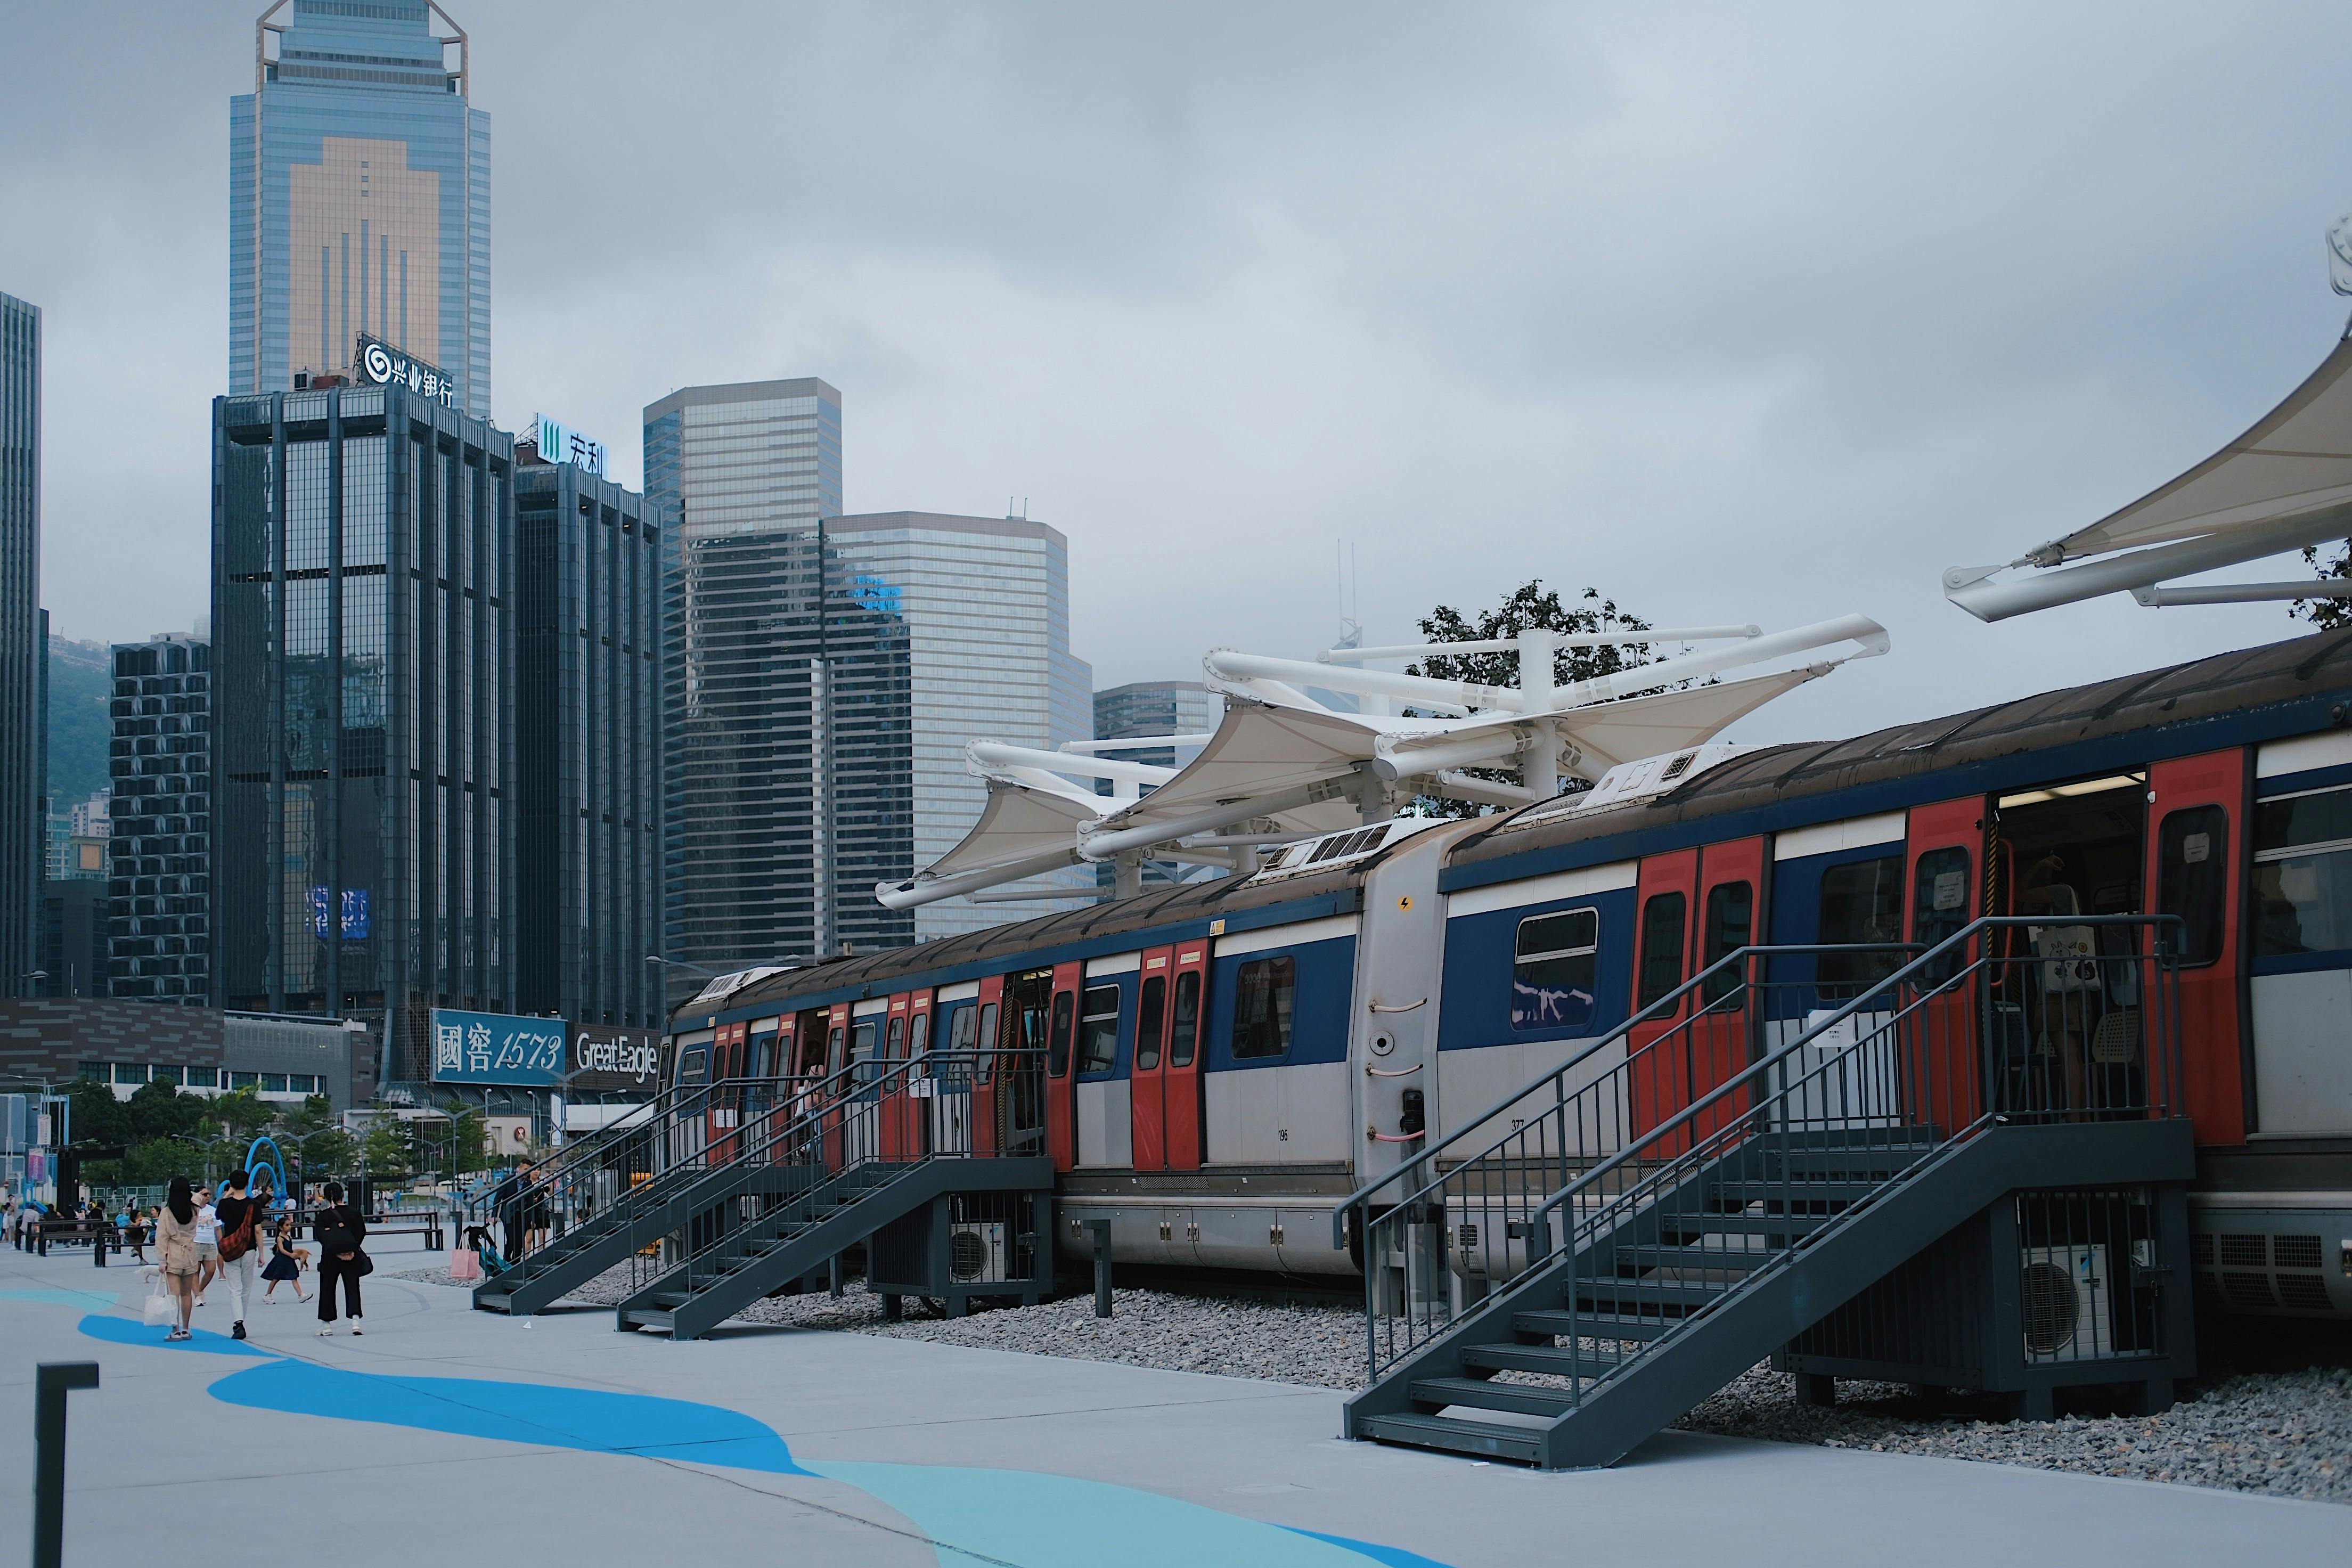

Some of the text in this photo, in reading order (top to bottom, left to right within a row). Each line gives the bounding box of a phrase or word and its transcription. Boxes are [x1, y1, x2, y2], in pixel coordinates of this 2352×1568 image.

[391, 357, 453, 409] 兴业银行
[570, 433, 602, 479] 宏利
[1279, 1129, 1288, 1141] 196
[1512, 1118, 1524, 1132] 377
